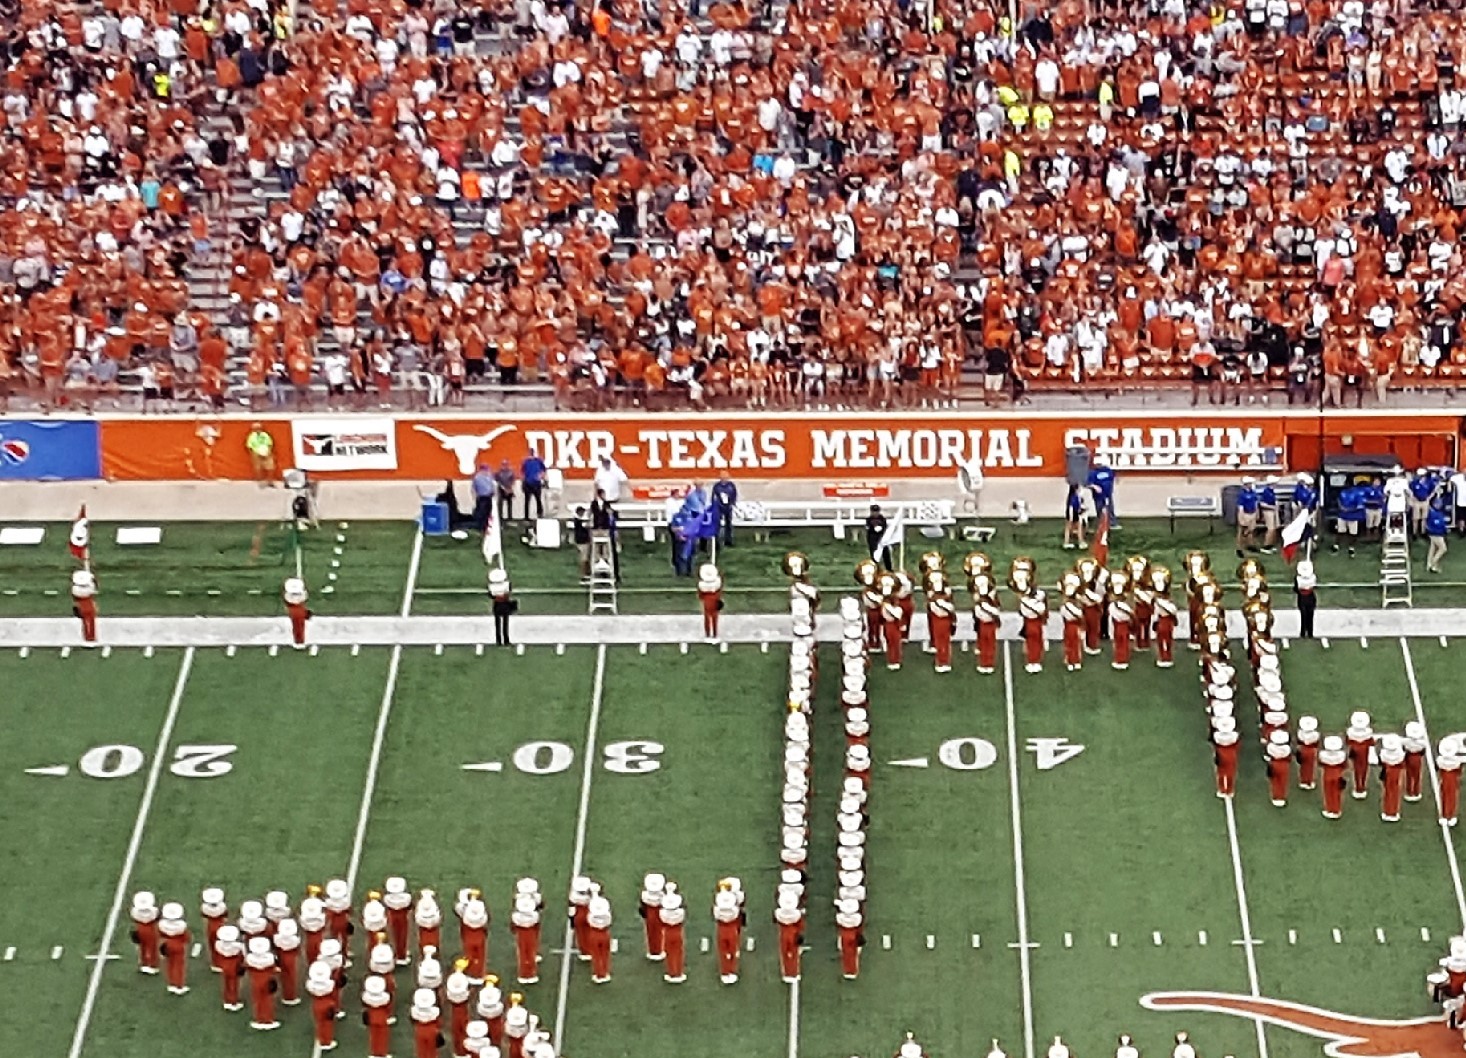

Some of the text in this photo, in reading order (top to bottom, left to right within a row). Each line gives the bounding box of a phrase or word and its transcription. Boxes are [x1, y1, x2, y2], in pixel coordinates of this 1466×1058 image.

[525, 428, 1263, 468] DKR-TEXAS MEMORIAL STADIUM
